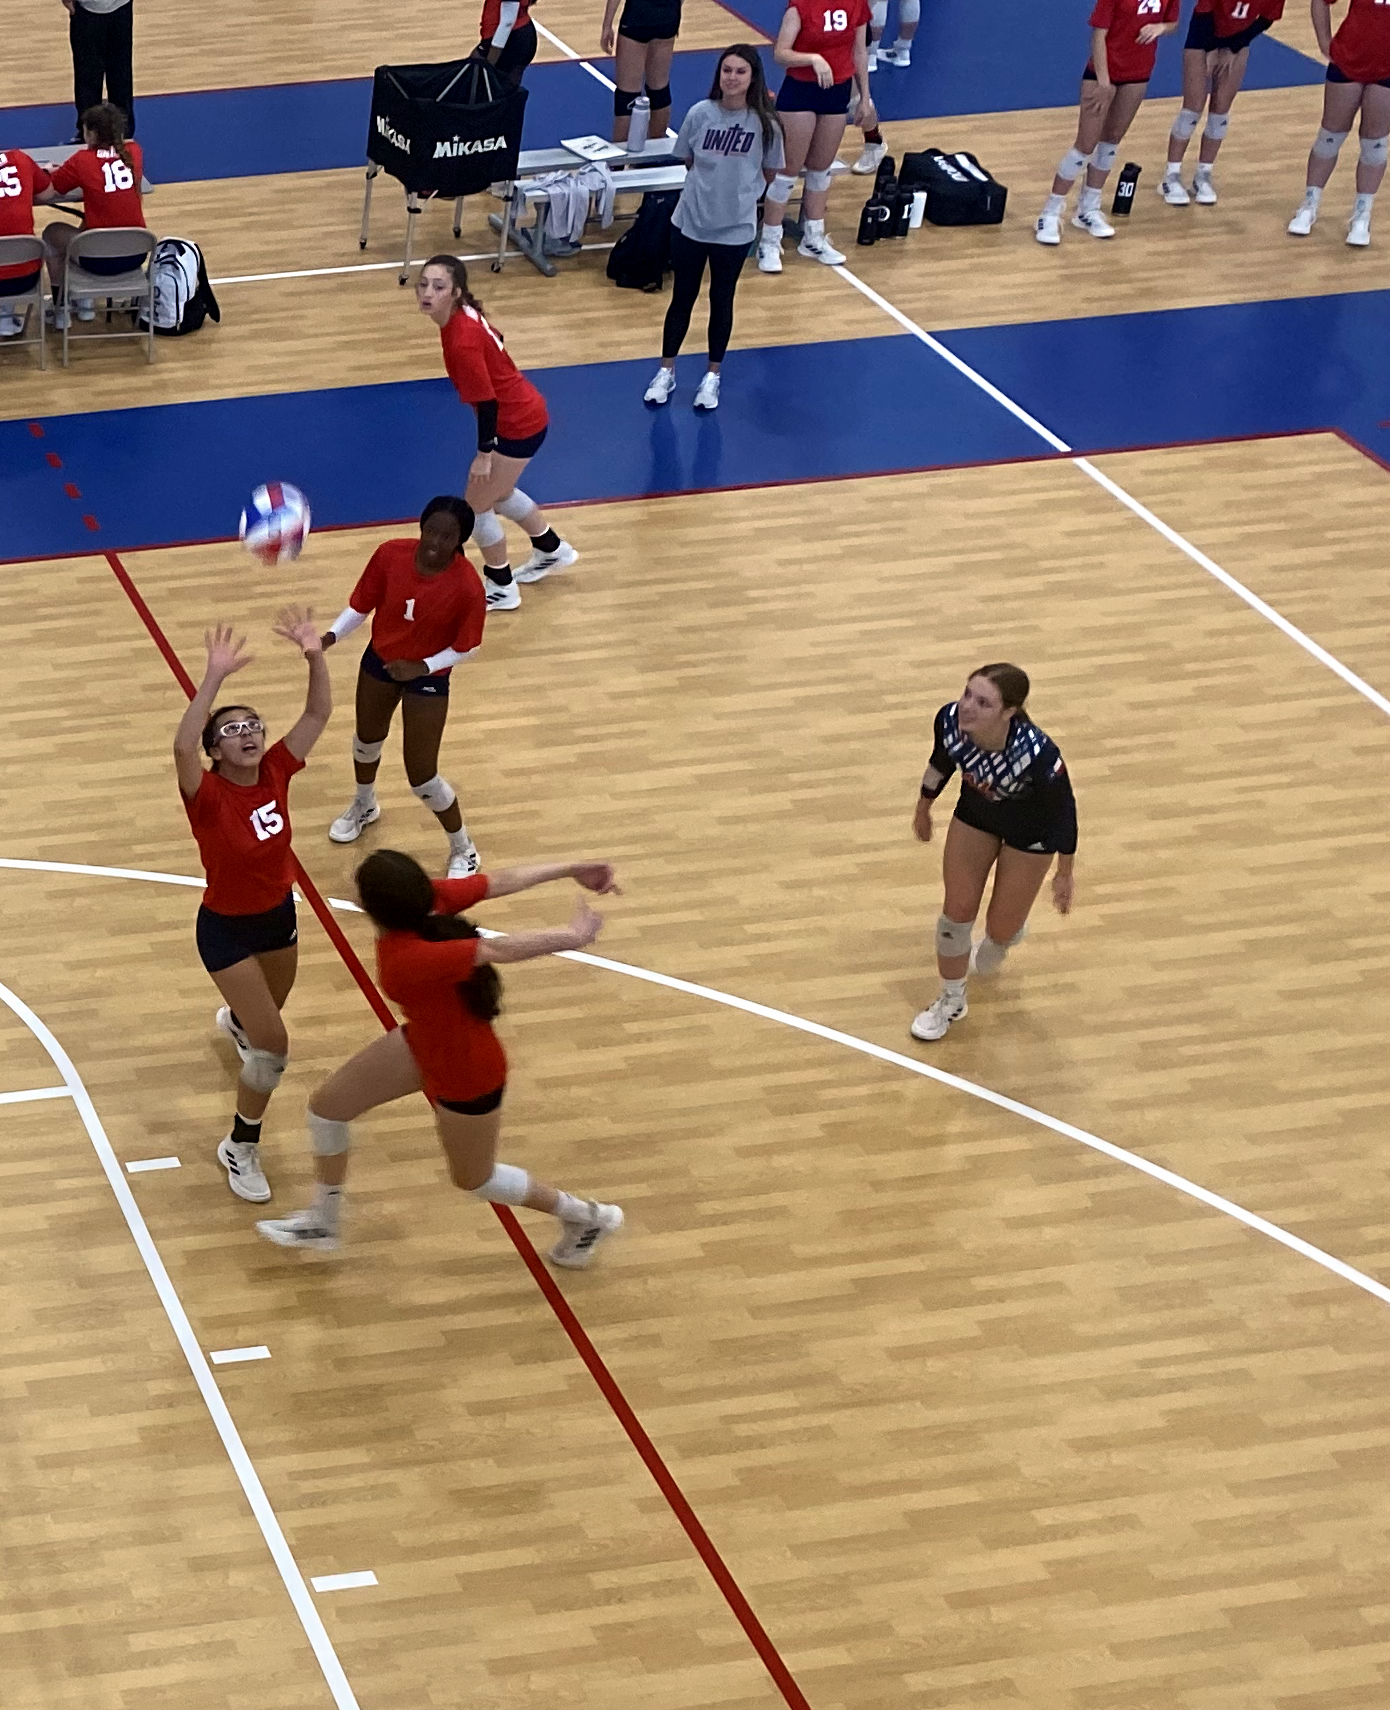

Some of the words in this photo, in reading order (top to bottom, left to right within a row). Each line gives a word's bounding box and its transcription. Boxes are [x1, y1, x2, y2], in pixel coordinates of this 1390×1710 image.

[1137, 0, 1162, 14] 24
[1231, 1, 1250, 18] 11
[823, 9, 848, 32] 19
[432, 134, 508, 159] MIKASA
[702, 123, 755, 156] UNITED
[101, 159, 134, 193] 16
[1118, 181, 1135, 197] 30
[403, 598, 416, 622] 1
[249, 799, 284, 841] 15
